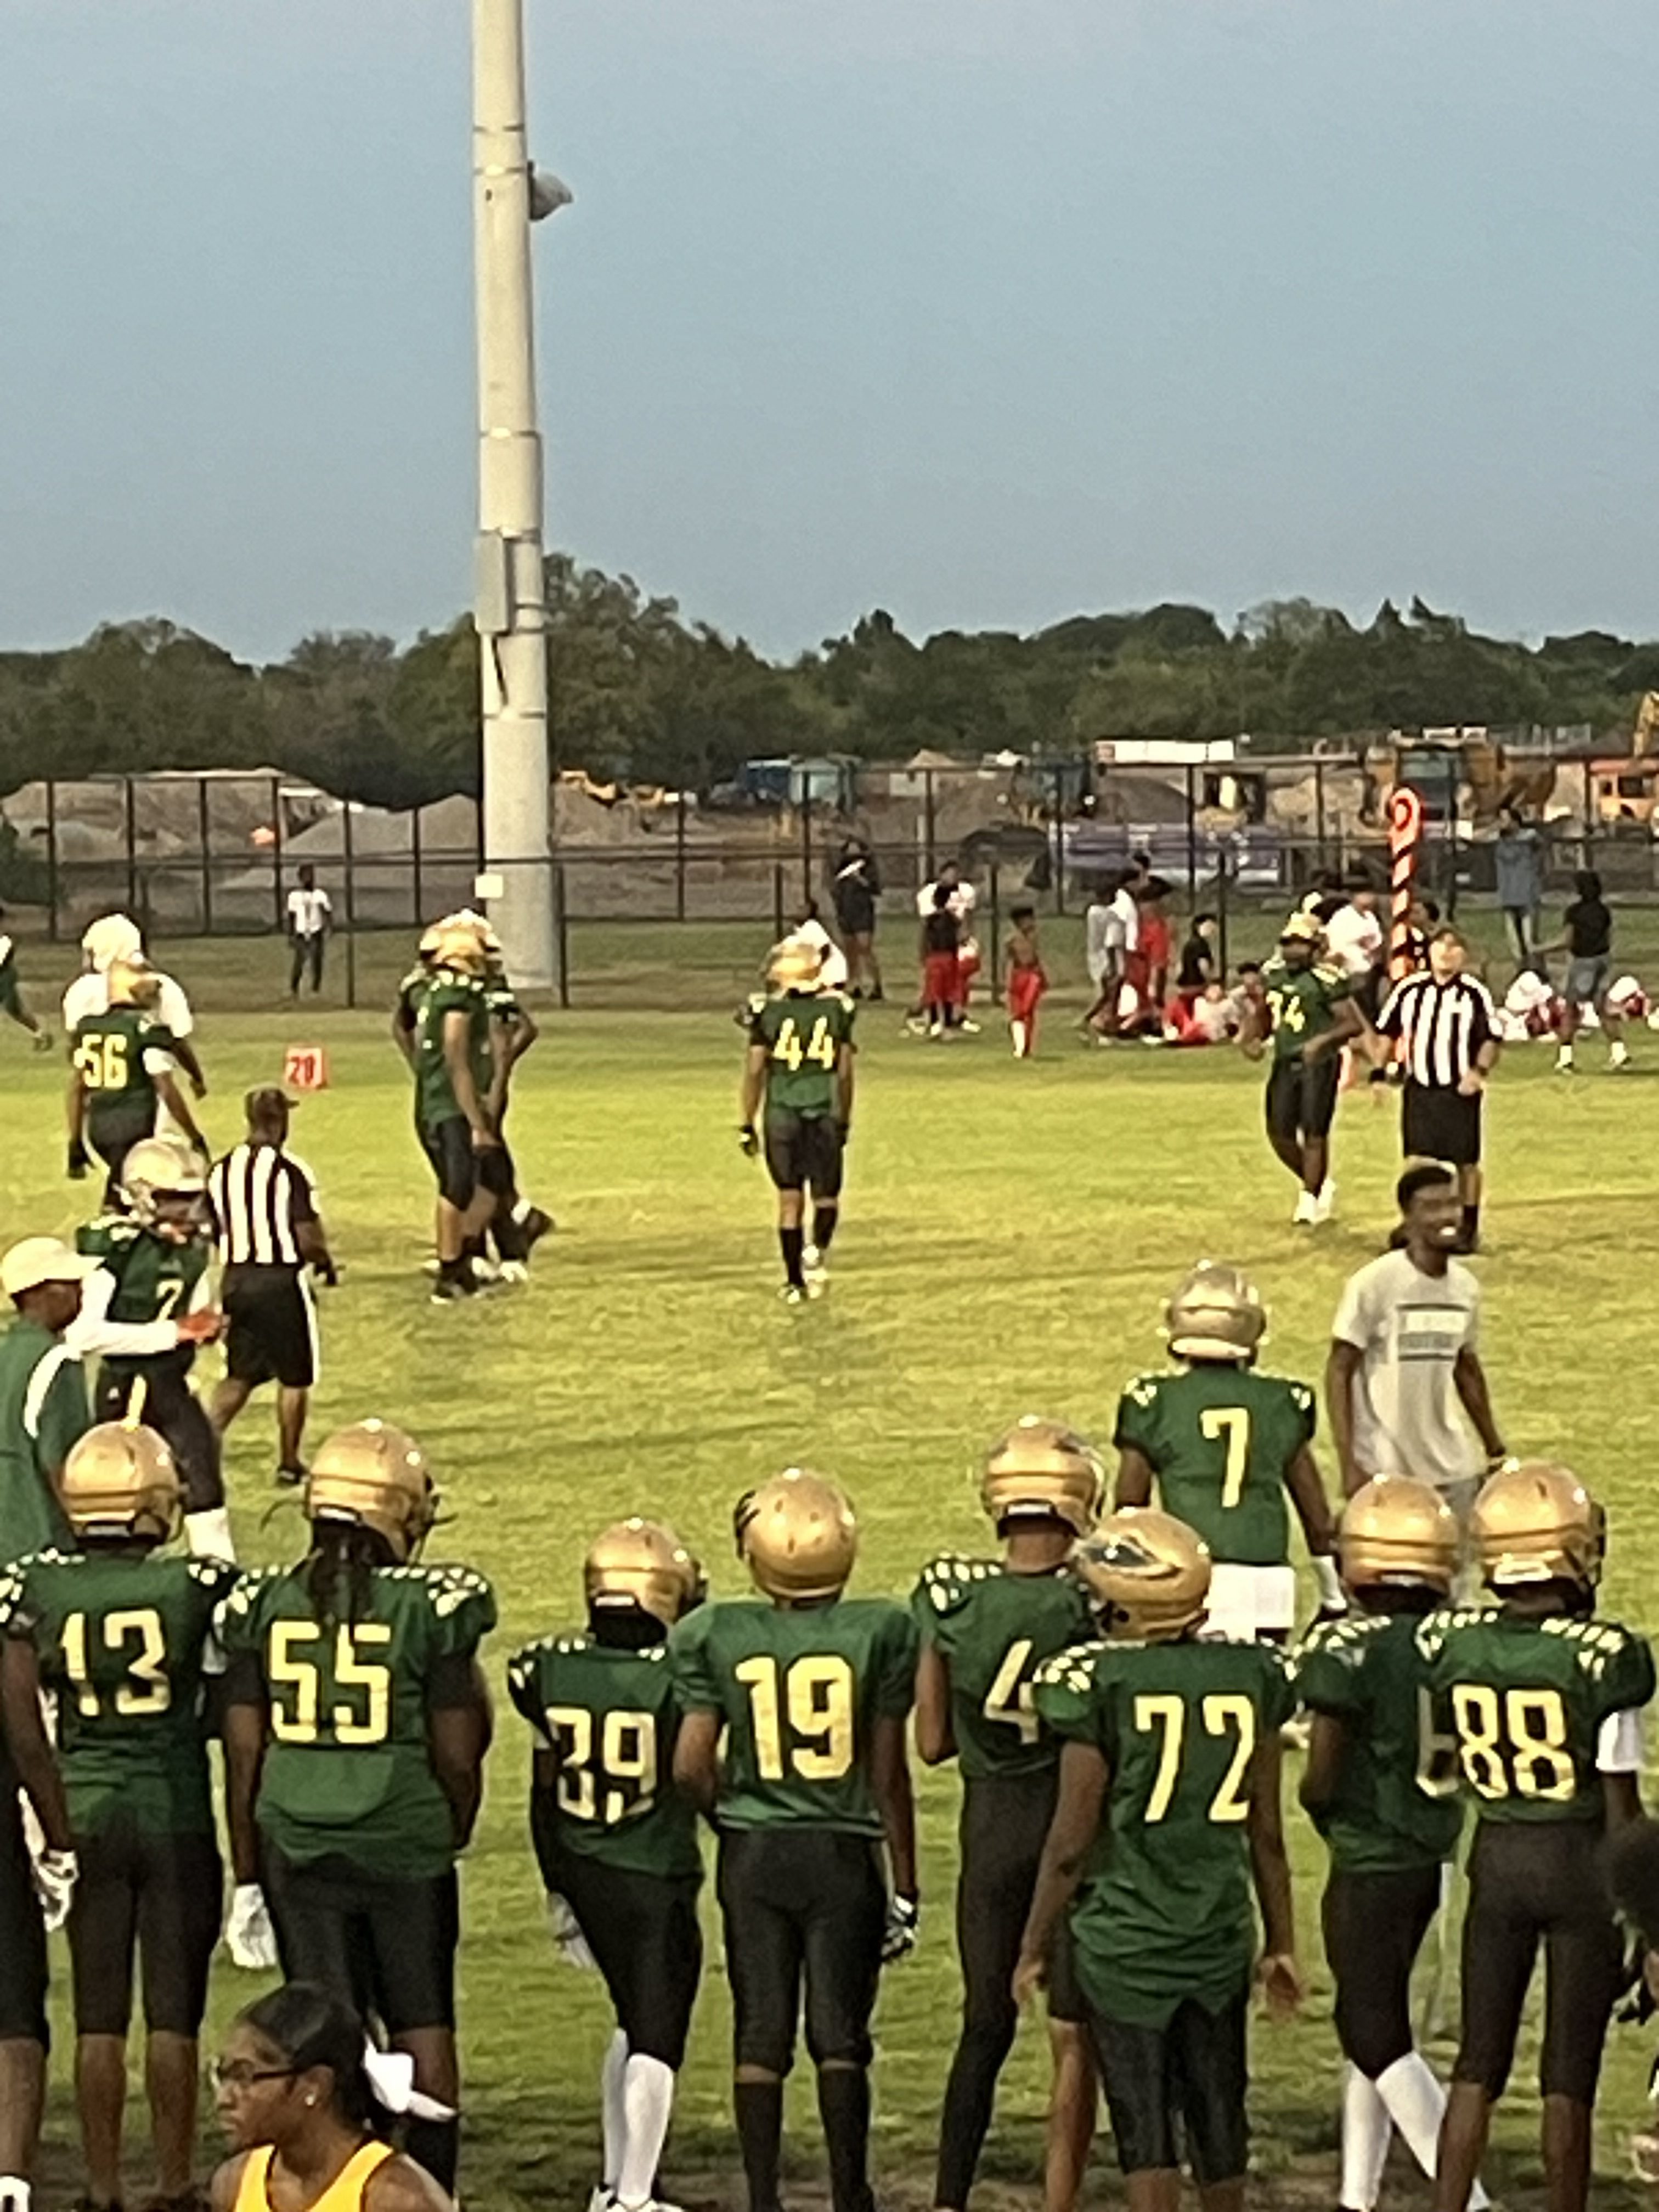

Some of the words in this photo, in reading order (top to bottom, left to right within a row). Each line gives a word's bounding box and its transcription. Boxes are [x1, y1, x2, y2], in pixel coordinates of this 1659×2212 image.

[82, 1034, 127, 1088] 56
[773, 1015, 835, 1070] 44
[1200, 1407, 1249, 1508] 7
[62, 1609, 170, 1716] 13
[269, 1621, 391, 1743] 55
[735, 1656, 853, 1780] 19
[545, 1707, 657, 1824] 39
[1134, 1695, 1255, 1822] 72
[1452, 1684, 1575, 1801] 88
